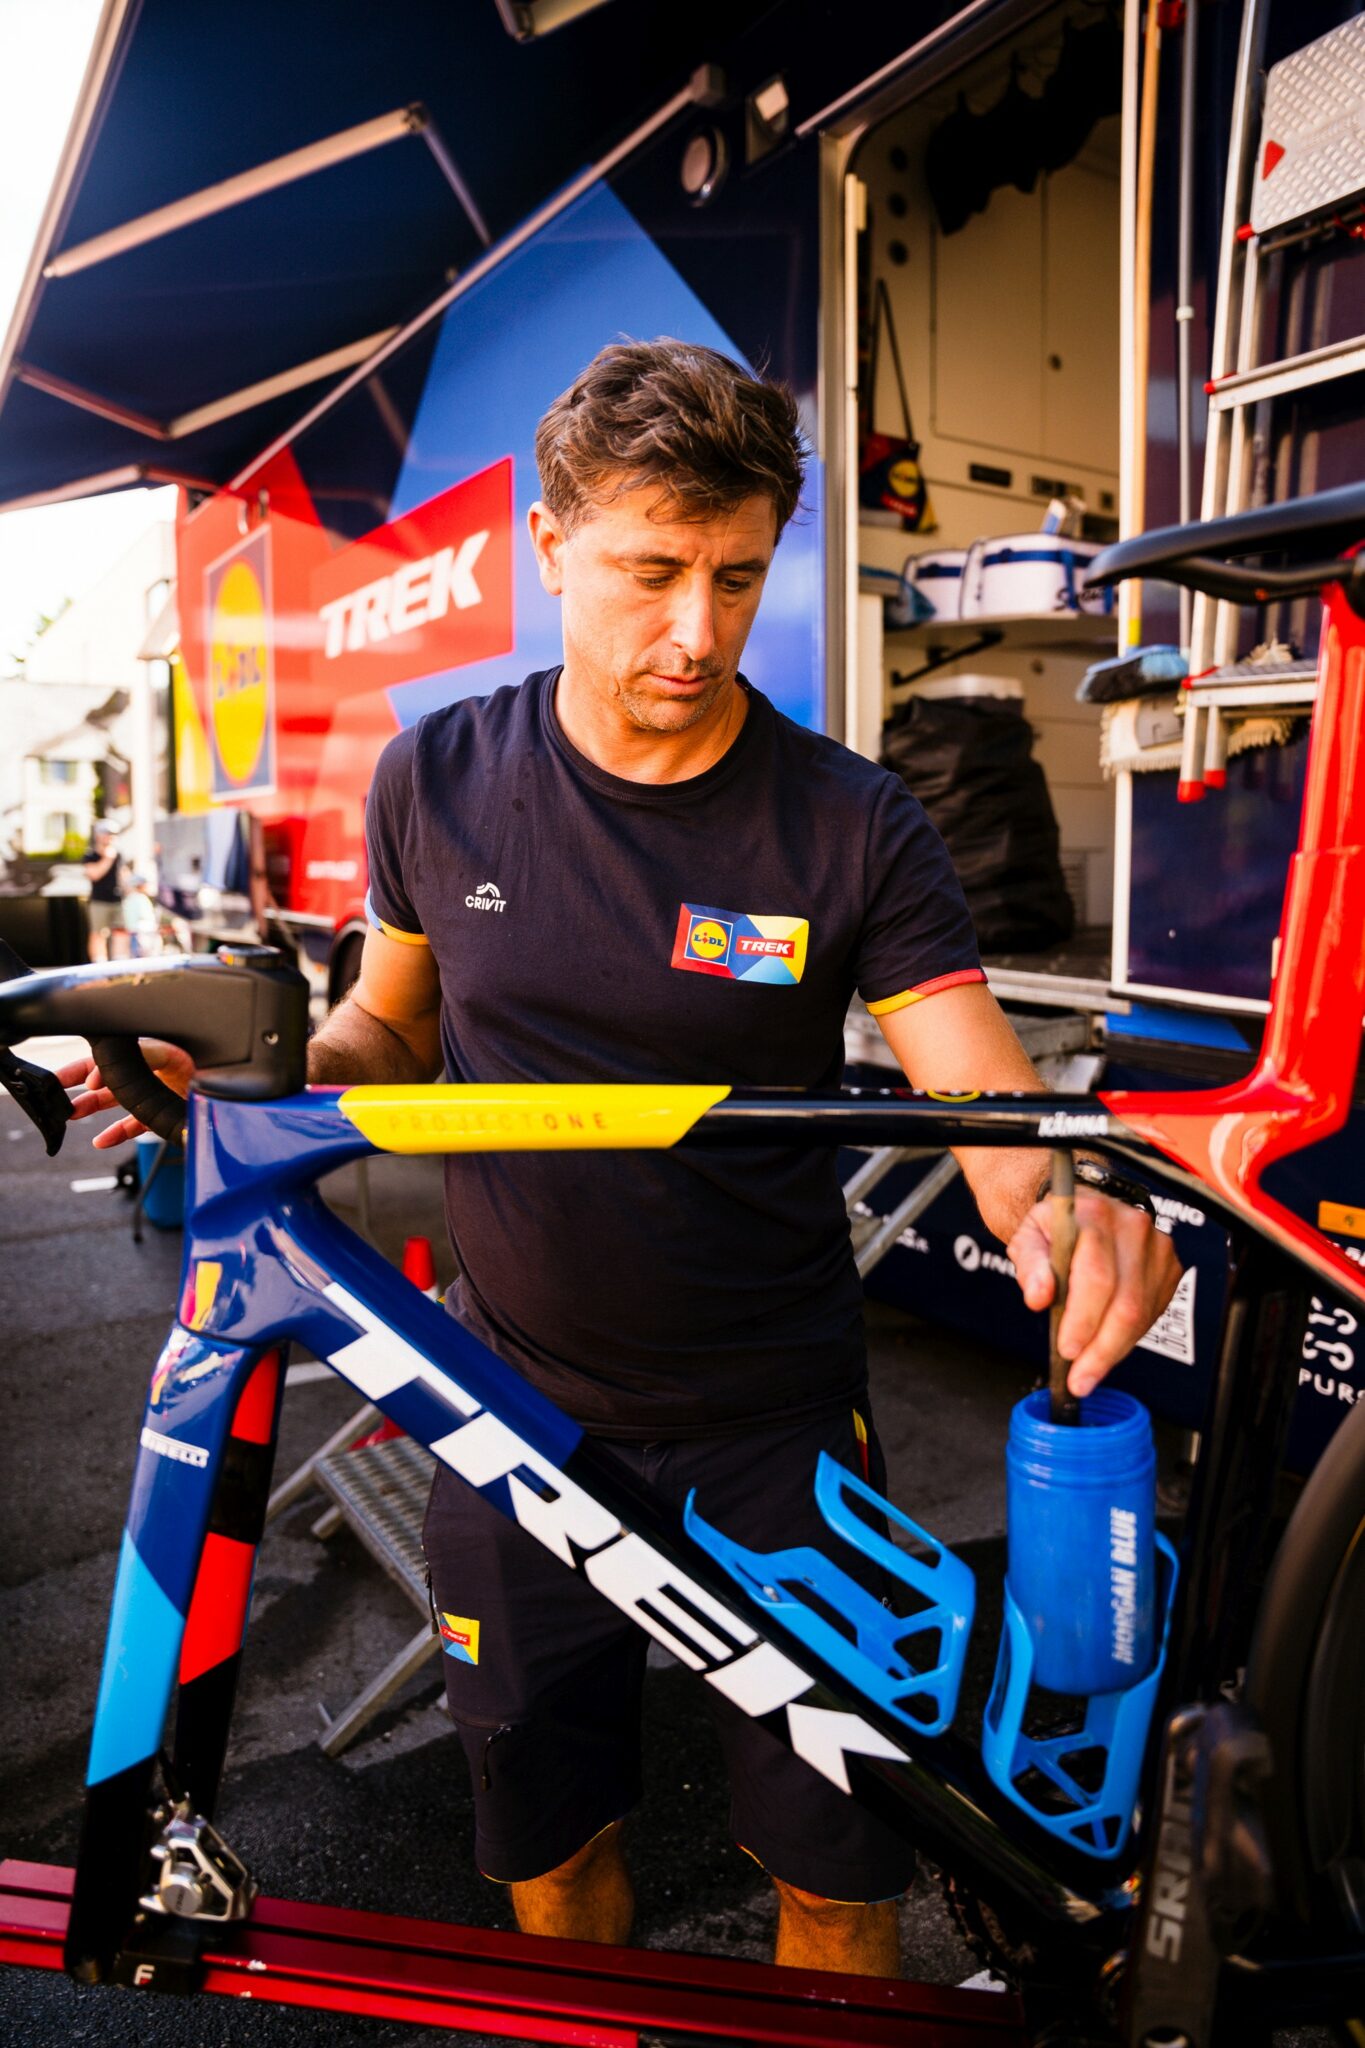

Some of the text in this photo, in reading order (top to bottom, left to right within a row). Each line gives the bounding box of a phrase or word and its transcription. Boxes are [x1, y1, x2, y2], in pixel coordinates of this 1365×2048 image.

[318, 529, 491, 660] TREK
[465, 895, 507, 912] CRIVIT
[741, 940, 791, 954] TREK
[1037, 1111, 1109, 1137] KÄMNA
[322, 1282, 912, 1795] TREK
[1110, 1506, 1137, 1665] MORGAN BLUE
